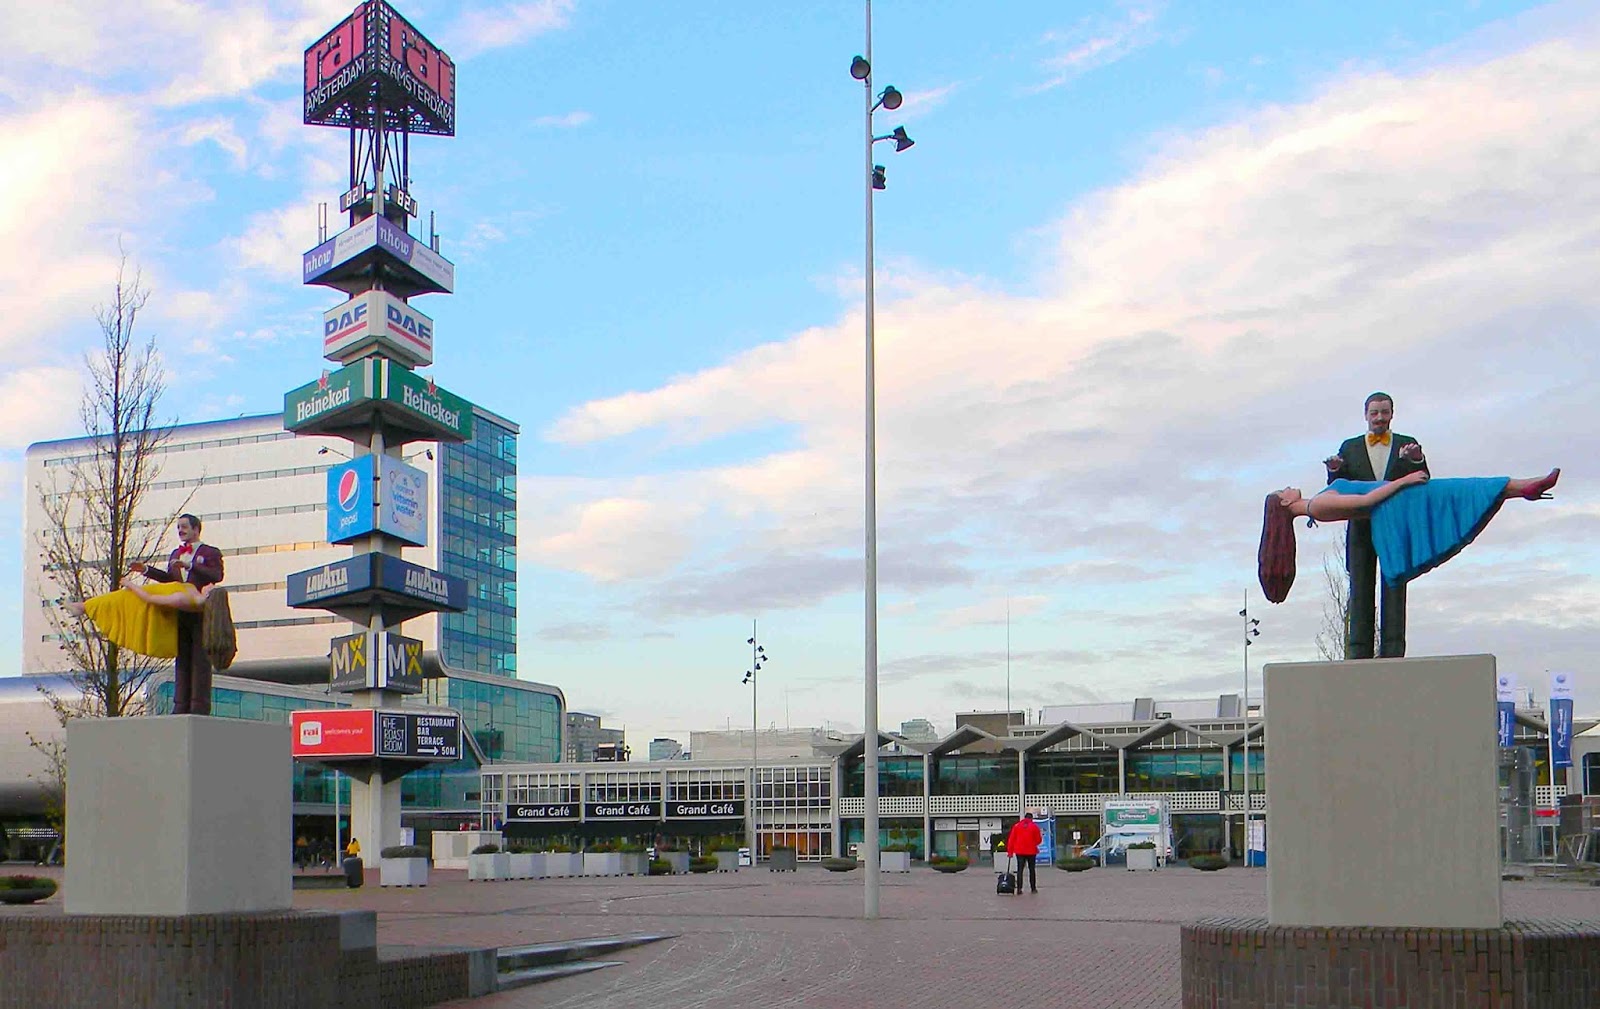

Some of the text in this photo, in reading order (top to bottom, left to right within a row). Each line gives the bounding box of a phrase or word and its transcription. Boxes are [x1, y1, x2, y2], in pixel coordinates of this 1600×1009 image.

[305, 2, 365, 93] rai
[306, 58, 365, 114] AMSTERDAM
[389, 60, 452, 125] AMSTERDAM
[380, 226, 410, 256] nhow
[305, 249, 331, 274] nhow
[325, 302, 368, 337] DAF
[387, 304, 431, 340] DAF
[297, 386, 350, 422] Heineken
[403, 385, 459, 430] Heineken
[306, 566, 348, 594] LAVAZZA
[405, 568, 449, 597] LAVAZZA
[303, 727, 319, 736] rai
[383, 718, 396, 729] THE
[417, 717, 455, 728] RESTAURANT
[417, 727, 430, 736] BAR
[384, 729, 404, 740] ROAST
[417, 736, 444, 746] TERRACE
[384, 740, 403, 752] ROOM
[441, 746, 456, 755] 50M
[517, 805, 570, 817] Grand Café
[595, 804, 651, 816] Grand Café
[676, 803, 735, 815] Grand Café
